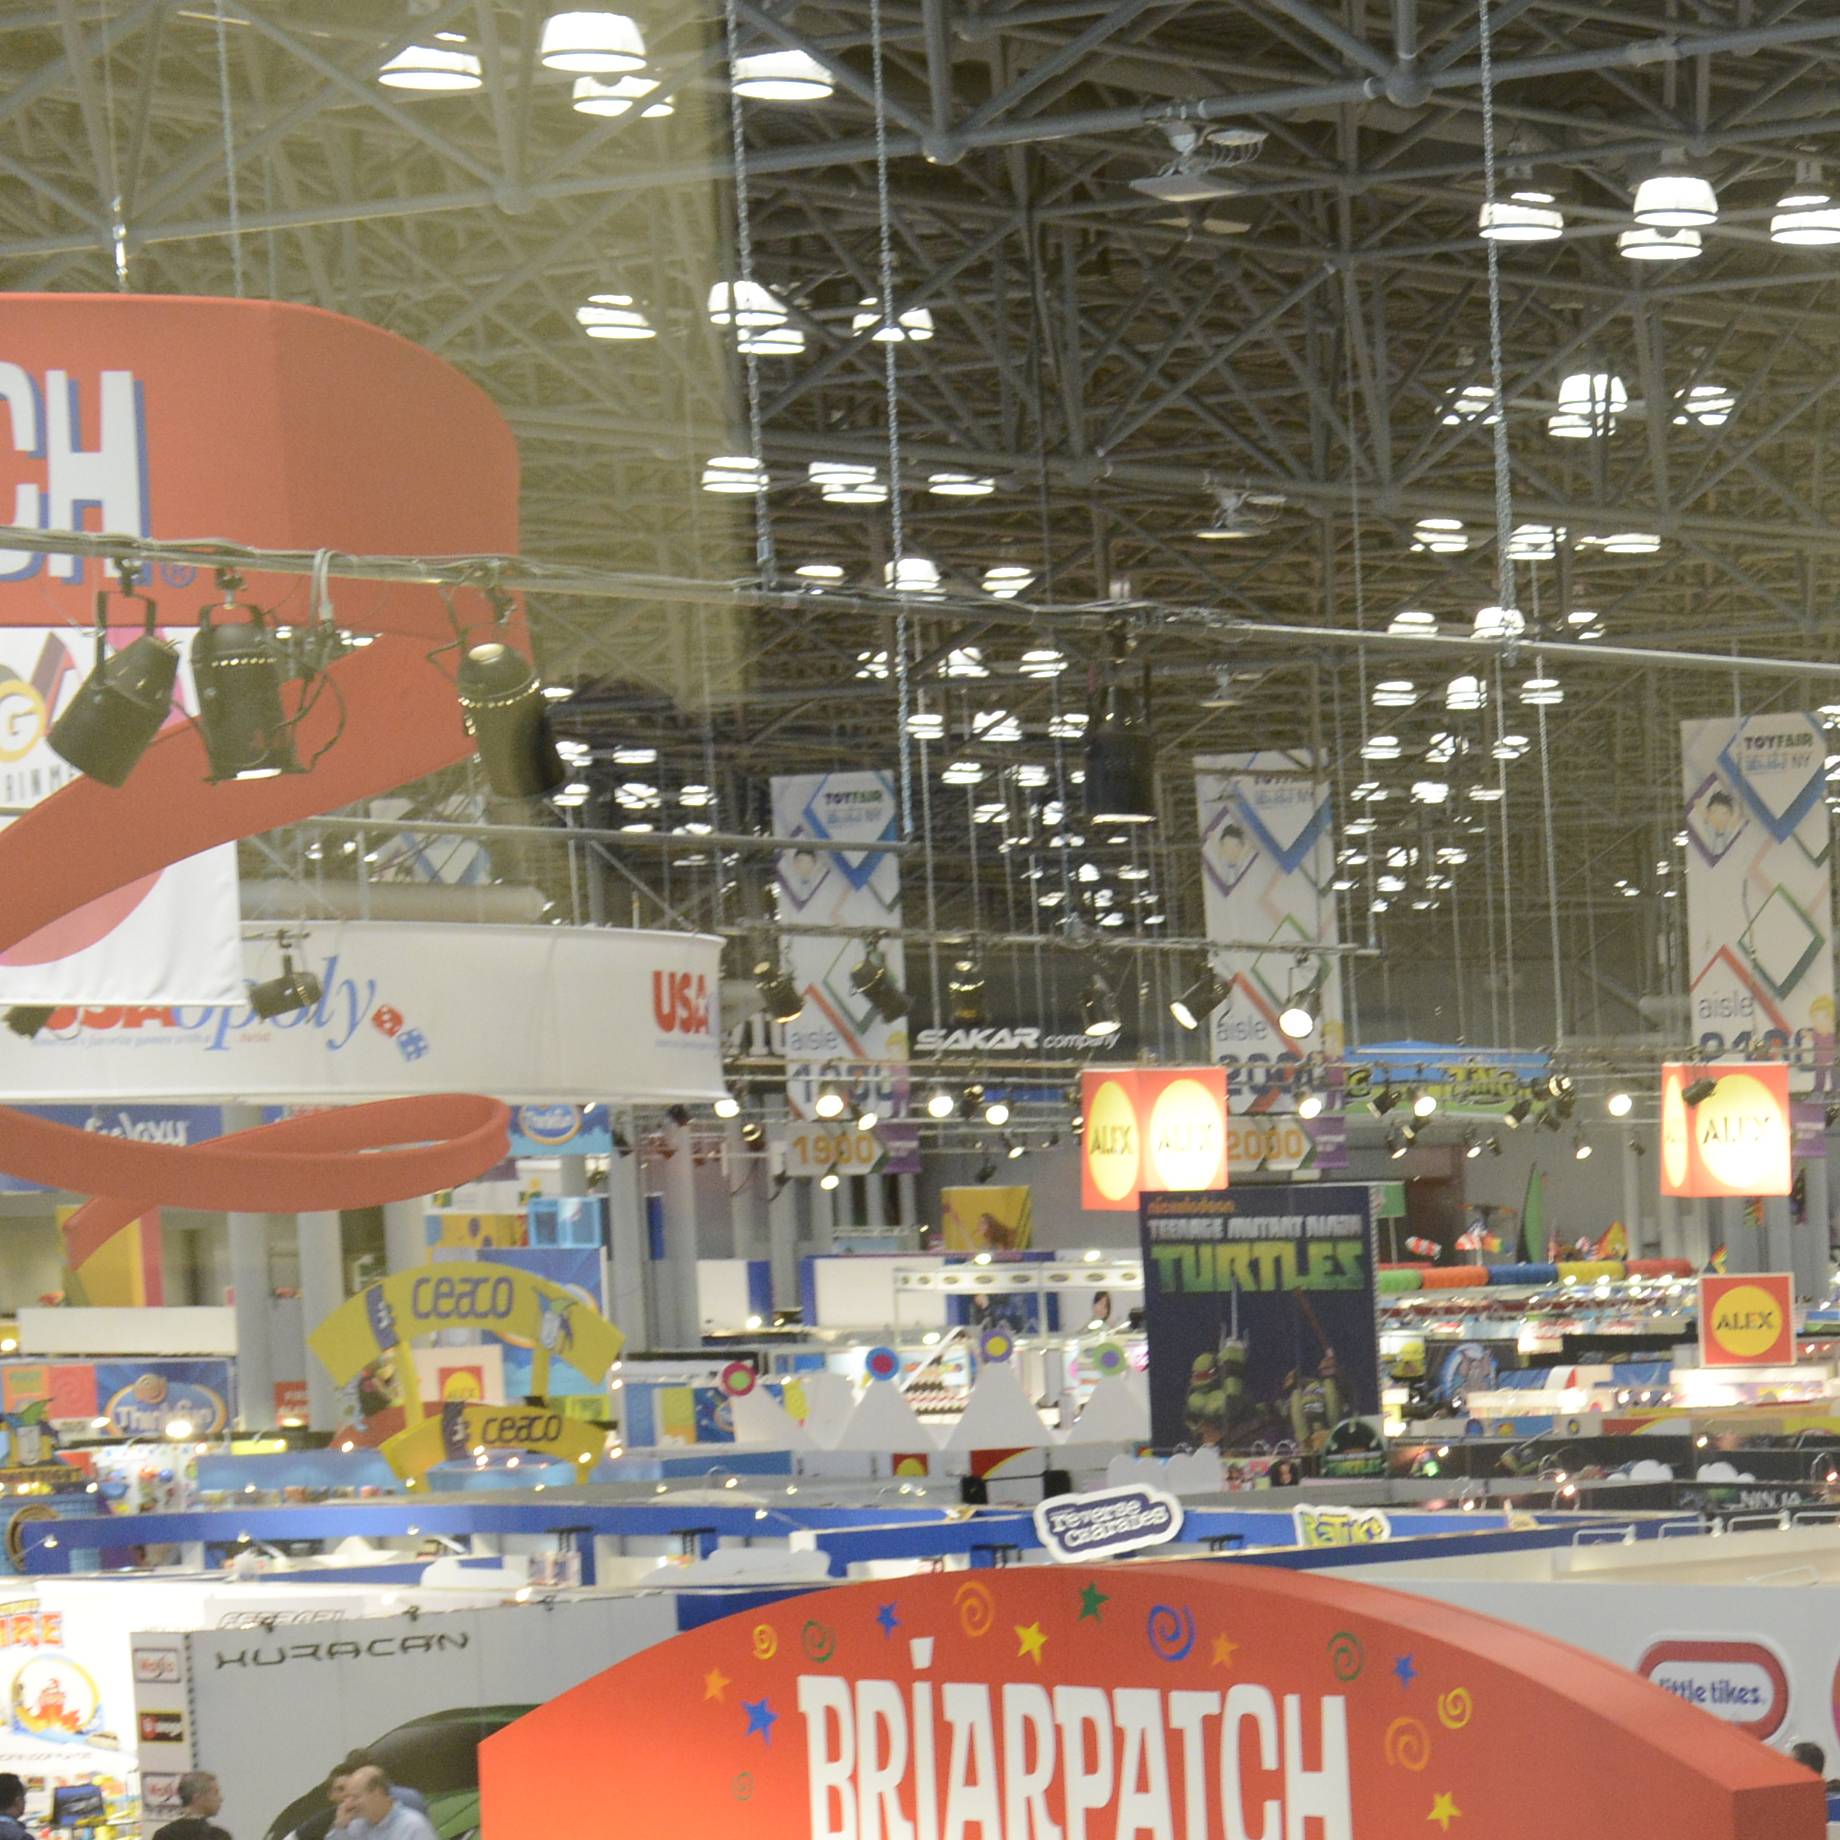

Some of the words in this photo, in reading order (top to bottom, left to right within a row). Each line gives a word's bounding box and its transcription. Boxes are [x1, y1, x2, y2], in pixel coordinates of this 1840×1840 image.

[1744, 731, 1814, 751] TOYFAIR
[651, 969, 710, 1036] USA
[1698, 992, 1754, 1019] aisle
[790, 1026, 839, 1053] aisle
[913, 1026, 1039, 1052] SAKAR
[1042, 1030, 1122, 1052] company
[1216, 1016, 1267, 1043] aisle
[795, 1132, 875, 1166] 1900
[1089, 1127, 1135, 1154] ALEX
[1227, 1128, 1304, 1161] 2000
[1148, 1240, 1367, 1293] TURTLES
[412, 1276, 515, 1321] ceaco
[1715, 1310, 1776, 1332] ALEX
[482, 1413, 563, 1445] ceaco
[1710, 1678, 1762, 1704] tikes
